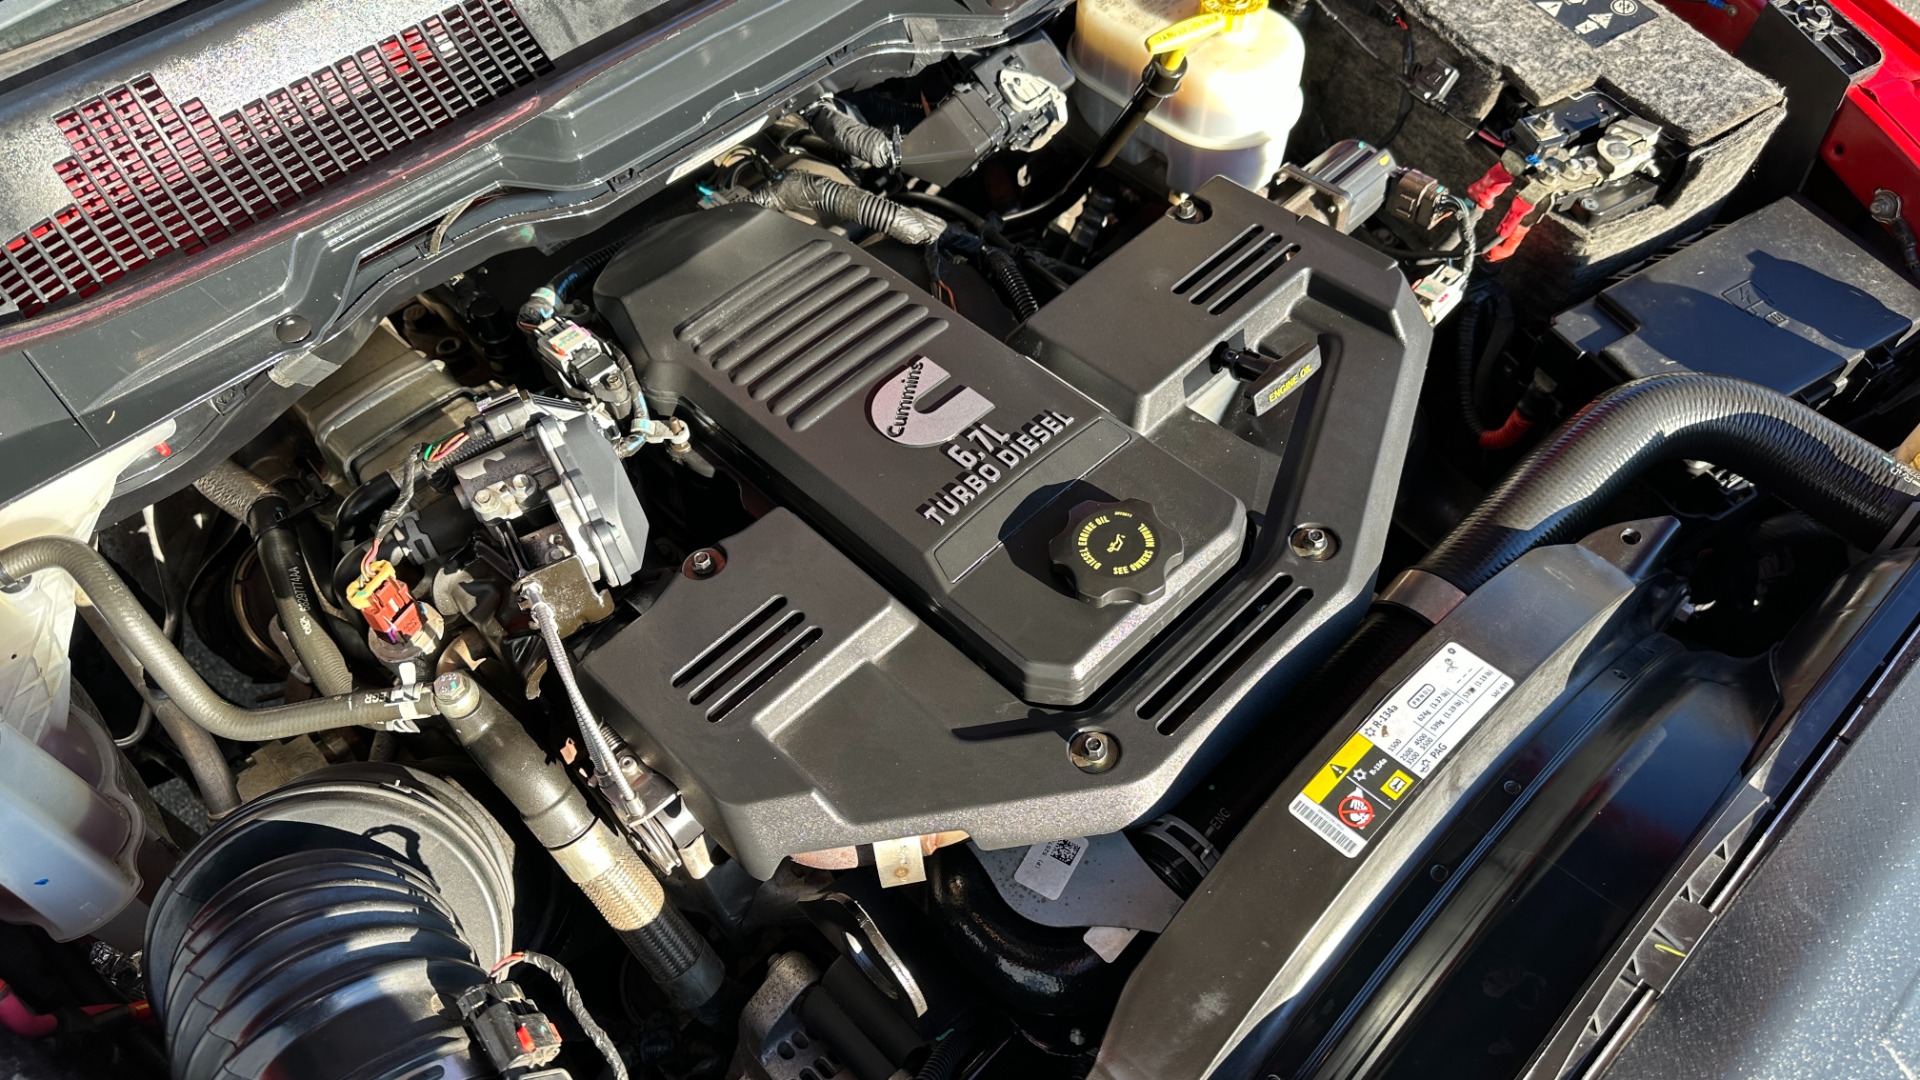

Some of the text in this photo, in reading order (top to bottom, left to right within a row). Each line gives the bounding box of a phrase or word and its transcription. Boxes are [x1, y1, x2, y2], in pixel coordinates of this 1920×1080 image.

[1268, 364, 1313, 402] ENGINE OIL
[887, 361, 924, 438] Cummins
[947, 423, 1011, 470] 6.7L
[923, 411, 1075, 526] TURBO DIESEL
[1078, 516, 1110, 570] DIESEL ENGINE OIL
[1113, 565, 1130, 575] SEE
[1137, 523, 1155, 548] MANUAL
[364, 691, 387, 704] EGR
[1372, 704, 1399, 729] R-134a
[1388, 739, 1402, 752] 1500
[1417, 708, 1432, 722] 624g
[1430, 718, 1445, 733] 539g
[1400, 733, 1428, 761] 2500 4500
[1406, 737, 1434, 766] 3500 5500
[1430, 743, 1448, 759] PAG
[1369, 758, 1388, 776] R-134a
[1209, 807, 1231, 830] ENG
